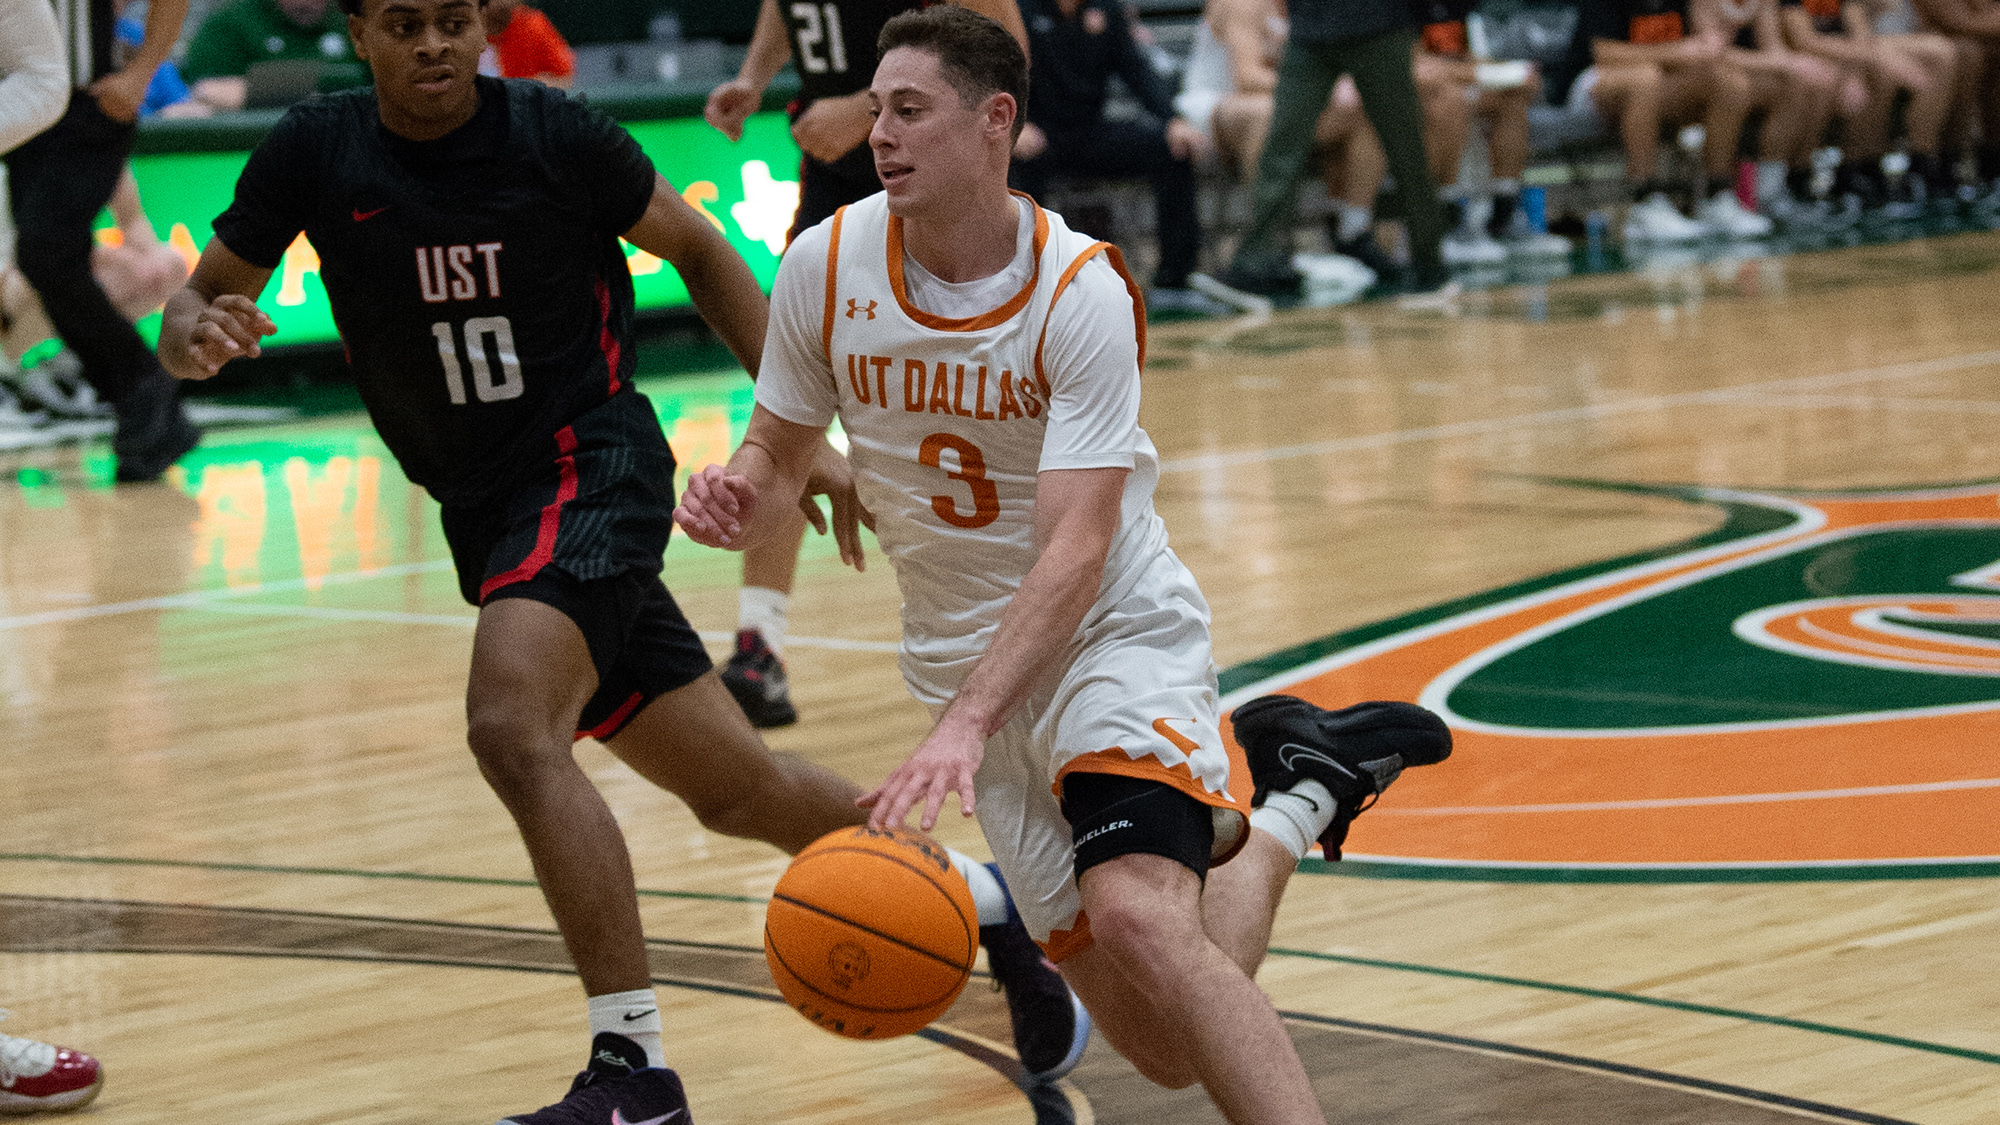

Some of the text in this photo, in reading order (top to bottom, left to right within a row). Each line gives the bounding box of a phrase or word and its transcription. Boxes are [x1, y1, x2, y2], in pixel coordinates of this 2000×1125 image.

[791, 2, 848, 73] 21
[415, 241, 503, 303] UST
[431, 315, 525, 405] 10
[848, 354, 1042, 421] UT DALLAS
[919, 433, 1000, 528] 3
